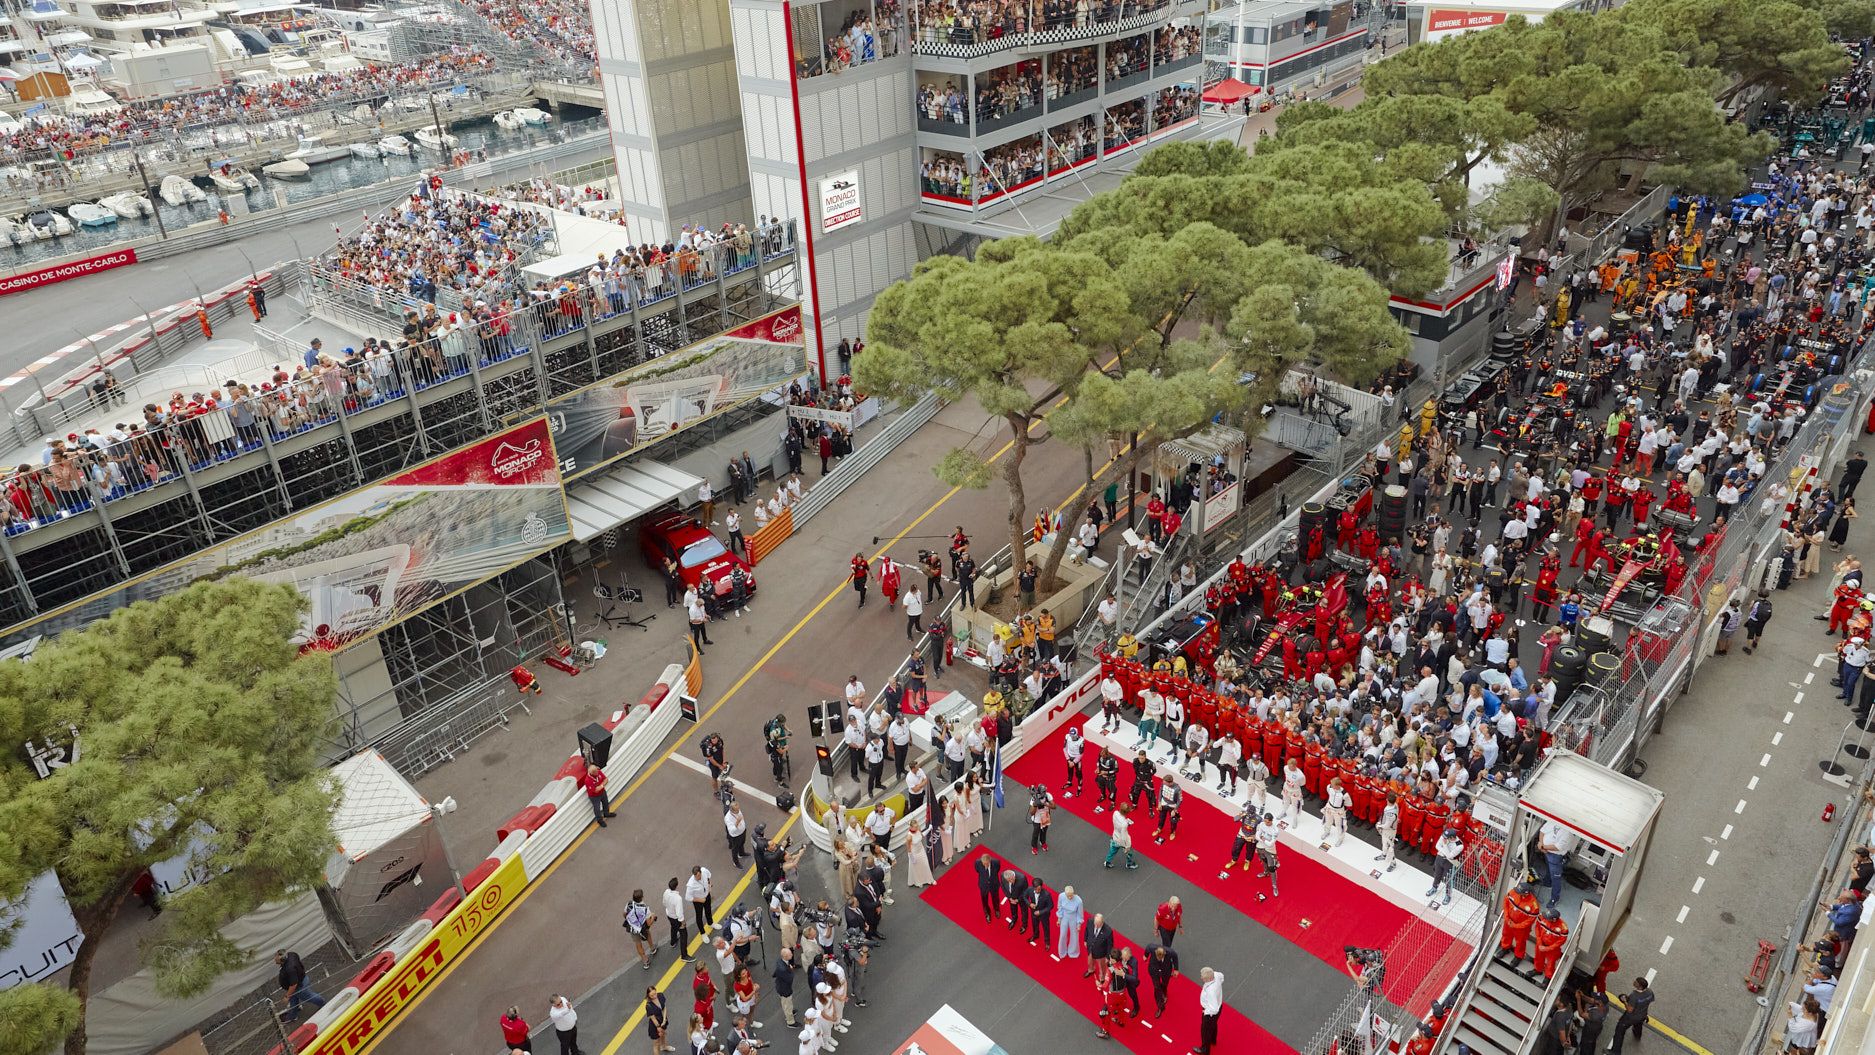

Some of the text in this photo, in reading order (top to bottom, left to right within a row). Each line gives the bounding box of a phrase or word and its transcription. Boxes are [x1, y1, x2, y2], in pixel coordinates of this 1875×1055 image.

[1434, 15, 1493, 28] BIENVENUE WELCOME
[825, 189, 856, 206] MONACO
[827, 199, 857, 213] GRAND PRIX
[824, 208, 860, 227] DIRECTION COURSE
[0, 254, 127, 290] CASINO DE MONTE-CARLO
[773, 323, 798, 337] MONACO
[493, 449, 542, 475] MONACO
[501, 459, 537, 478] CIRCUIT
[450, 884, 502, 938] 150
